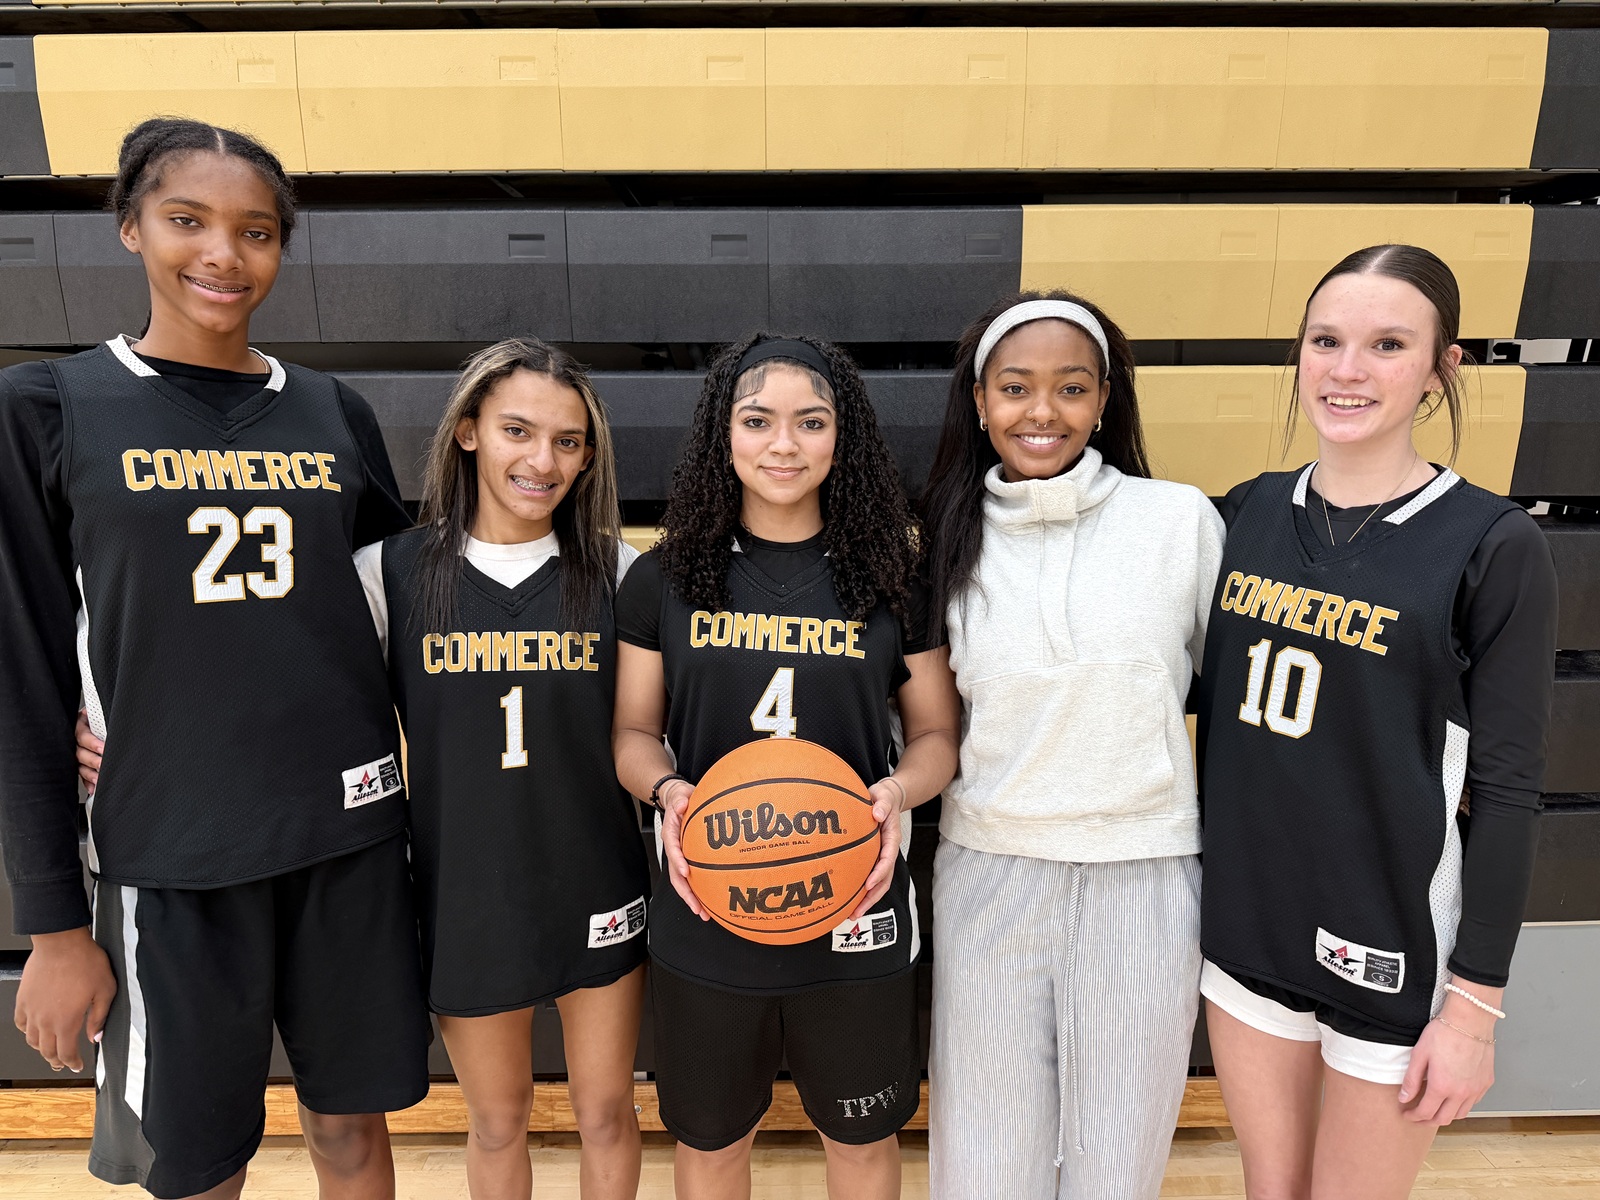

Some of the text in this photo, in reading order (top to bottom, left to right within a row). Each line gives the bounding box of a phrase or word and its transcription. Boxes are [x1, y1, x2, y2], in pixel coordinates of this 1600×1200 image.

[122, 449, 342, 492] COMMERCE
[187, 506, 294, 604] 23
[690, 610, 867, 659] COMMERCE
[1220, 571, 1400, 656] COMMERCE
[422, 631, 601, 674] COMMERCE
[750, 667, 798, 739] 4
[1238, 638, 1323, 739] 10
[500, 686, 529, 770] 1
[704, 802, 842, 850] Wilson
[739, 845, 766, 853] INDOOR
[769, 841, 790, 849] GAME
[728, 871, 834, 914] NCAA
[729, 901, 835, 921] OFFICIAL GAME BALL
